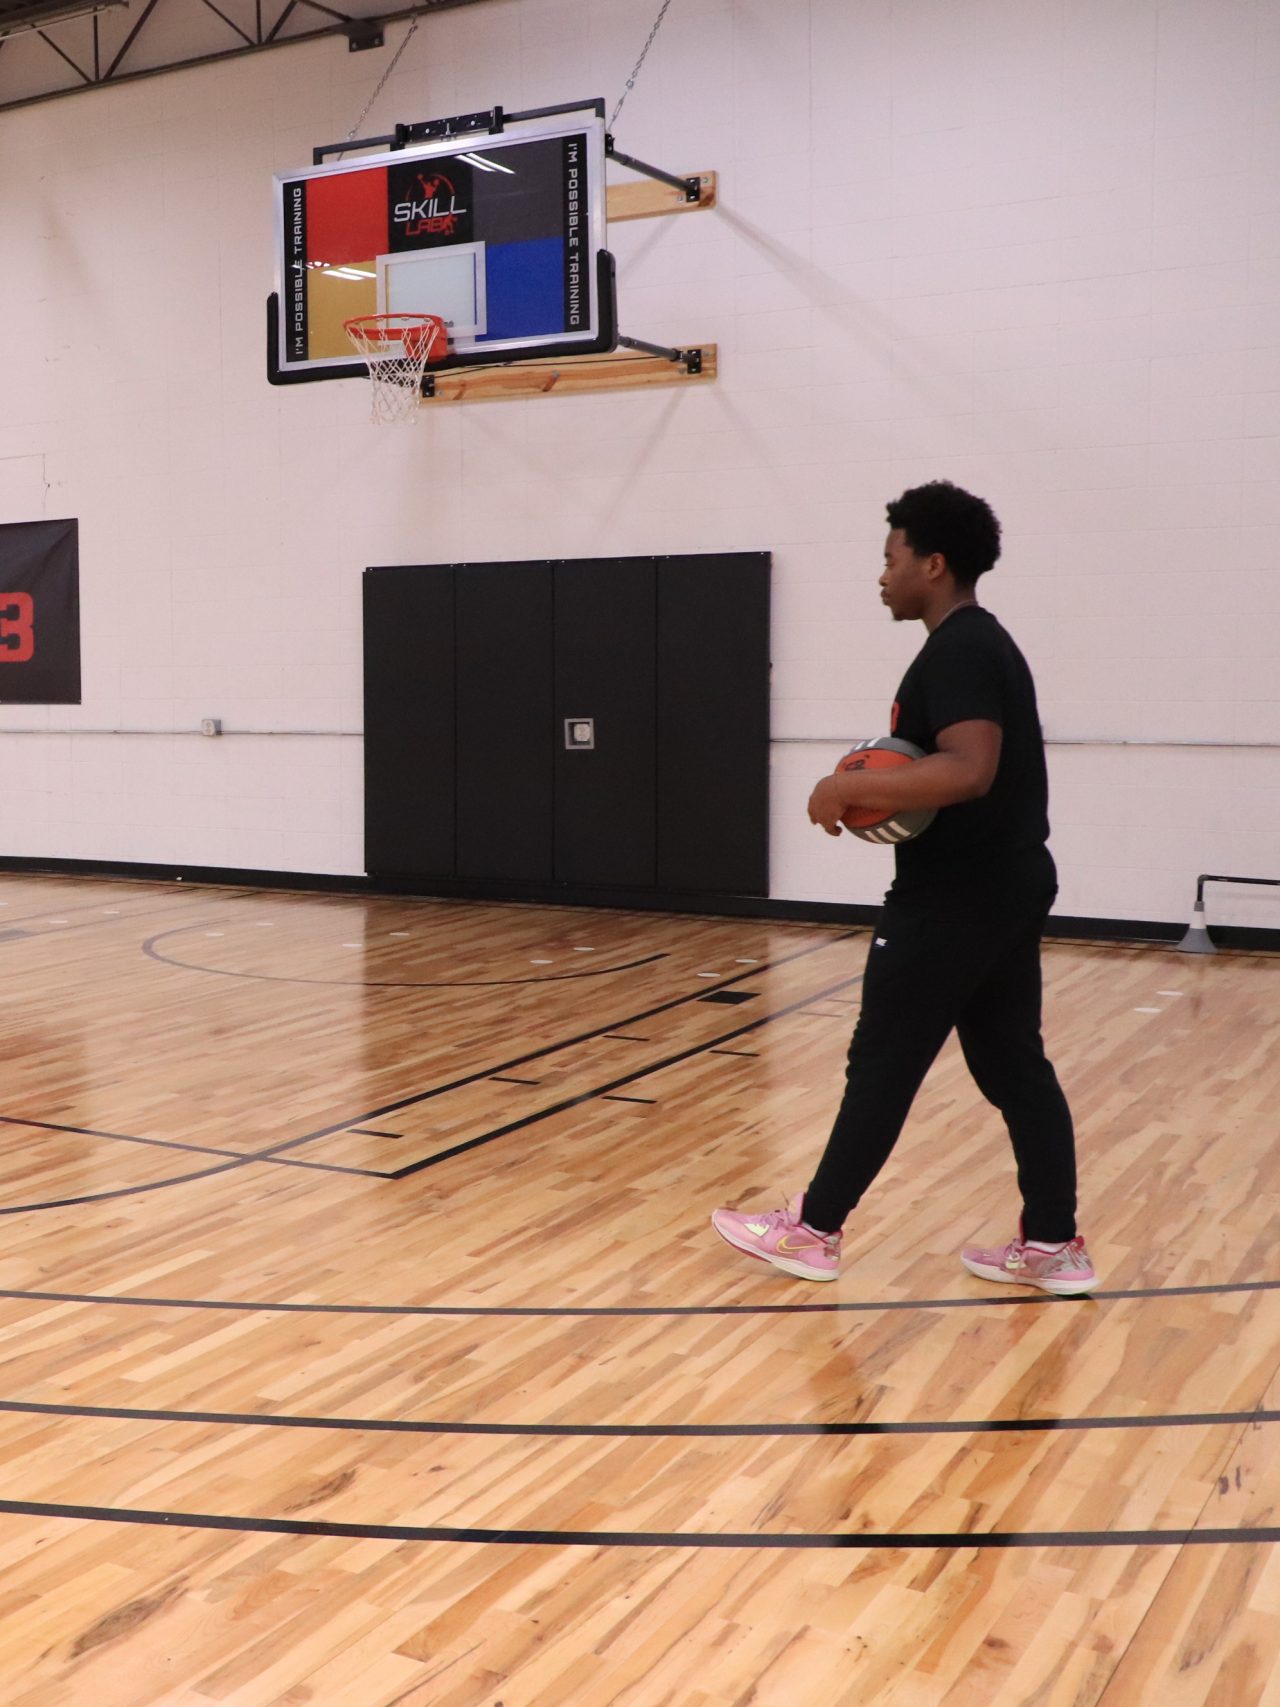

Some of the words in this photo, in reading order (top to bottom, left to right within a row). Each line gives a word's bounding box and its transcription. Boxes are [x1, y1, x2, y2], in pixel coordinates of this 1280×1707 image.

[568, 143, 578, 163] I'M
[293, 187, 303, 254] TRAINING
[393, 195, 467, 222] SKILL
[568, 168, 579, 247] POSSIBLE
[294, 259, 304, 332] POSSIBLE
[569, 252, 580, 325] TRAINING
[295, 336, 304, 355] I'M
